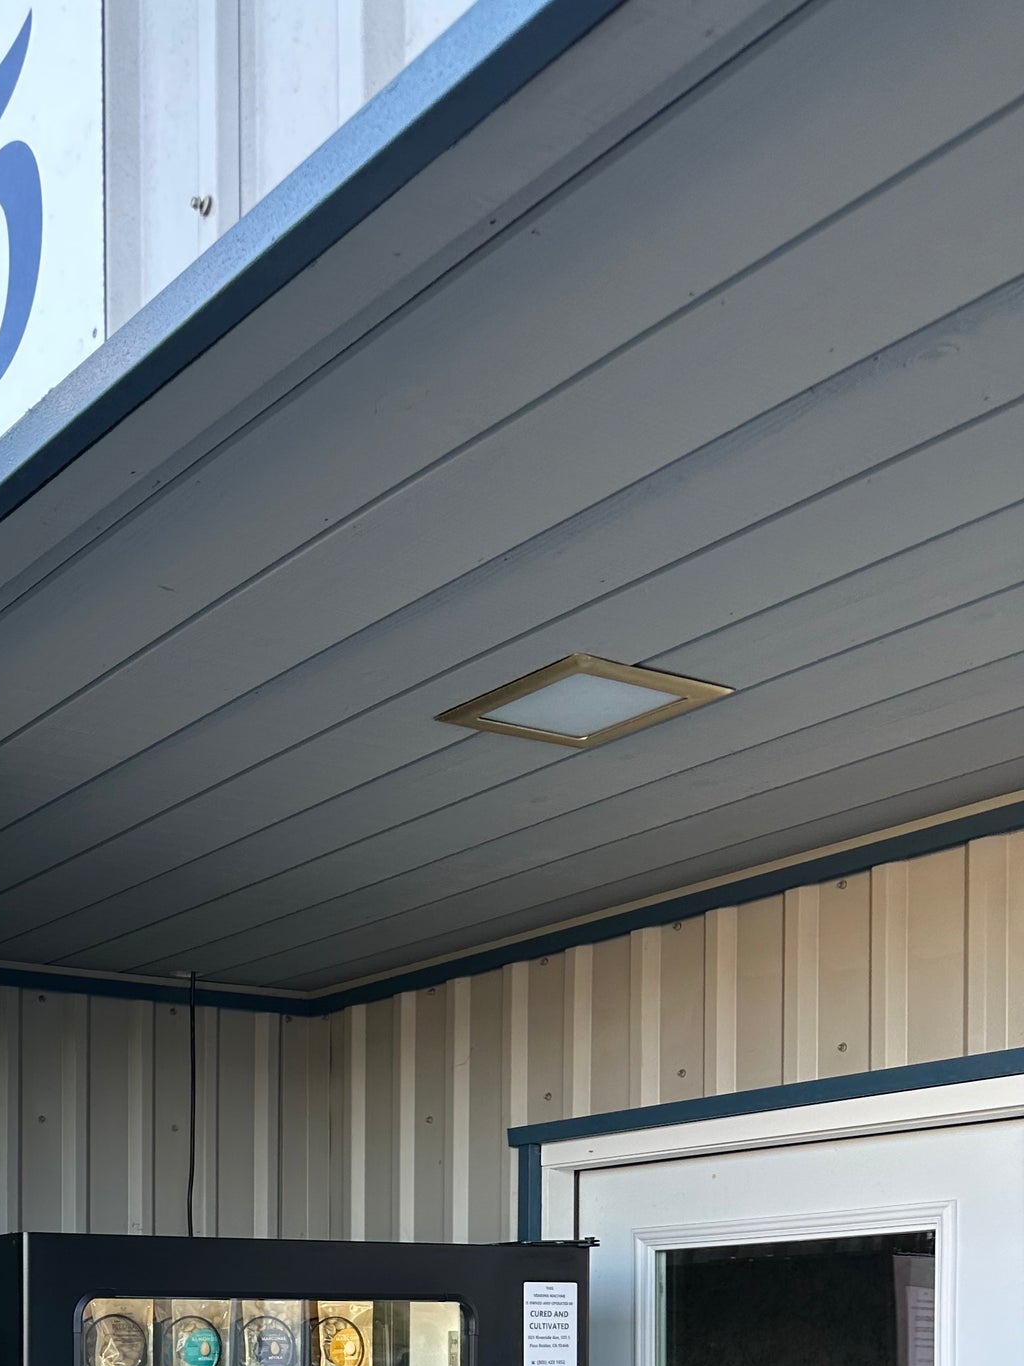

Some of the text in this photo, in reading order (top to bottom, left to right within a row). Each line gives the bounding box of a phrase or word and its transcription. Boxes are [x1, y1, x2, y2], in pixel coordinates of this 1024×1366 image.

[530, 1310, 569, 1318] CURED AND
[529, 1322, 570, 1330] CULTIVATED
